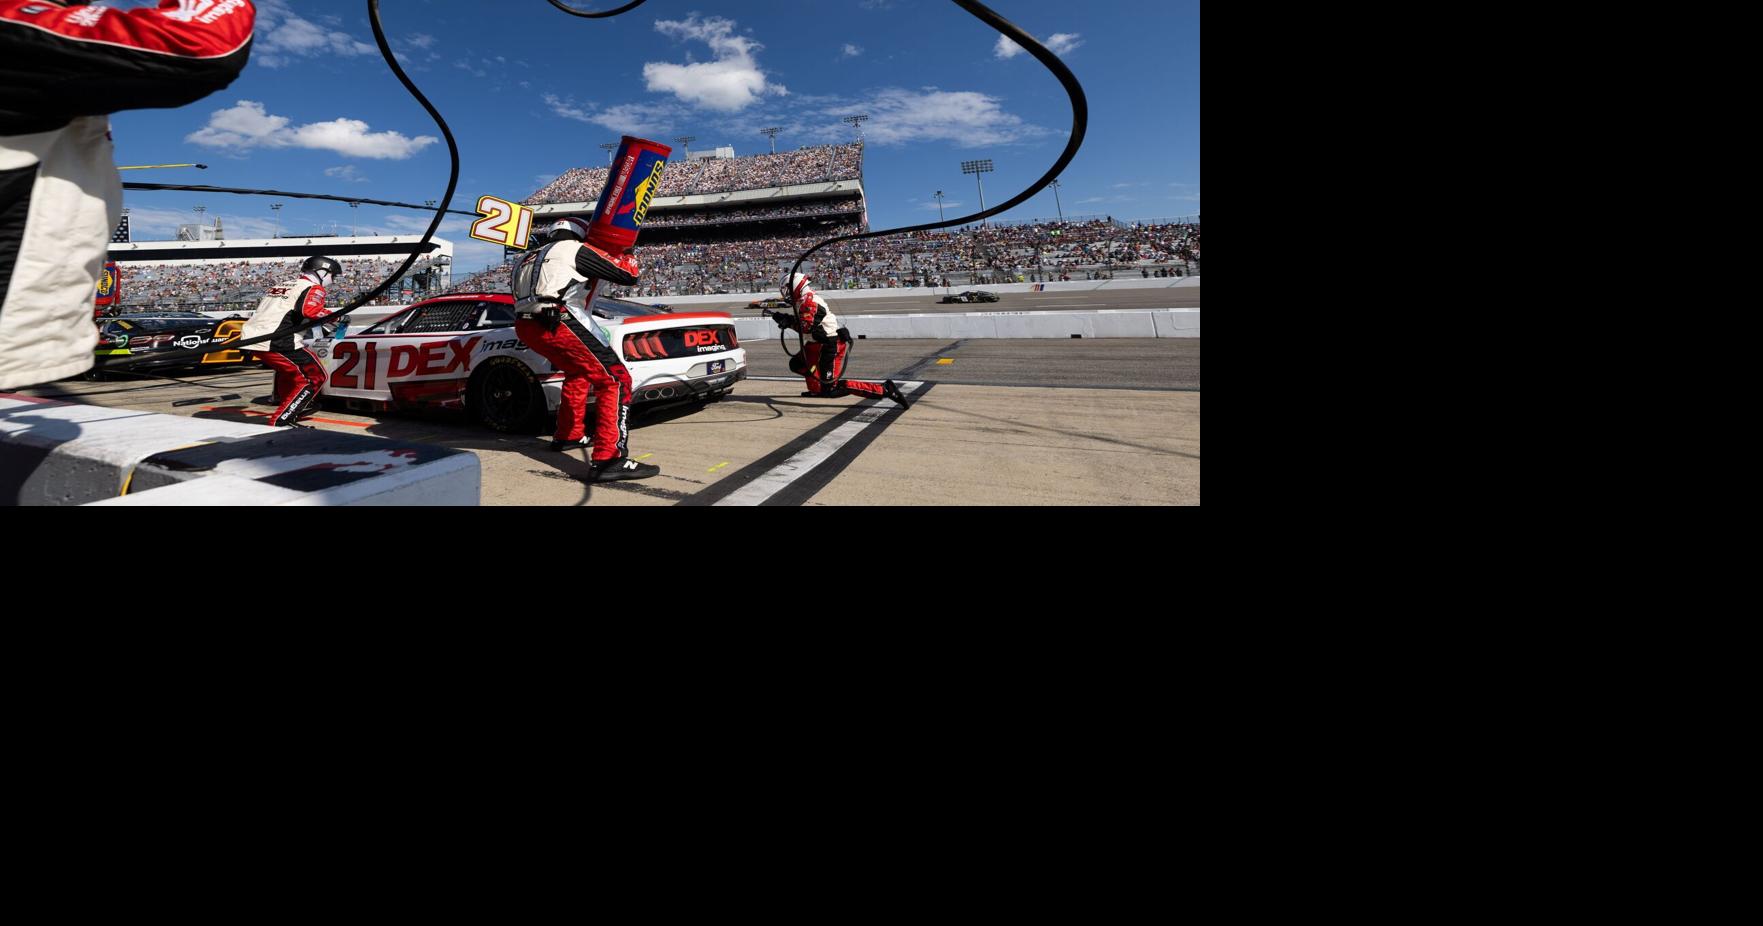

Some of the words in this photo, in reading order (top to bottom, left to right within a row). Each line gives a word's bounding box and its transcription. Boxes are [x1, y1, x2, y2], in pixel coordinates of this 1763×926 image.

[633, 160, 664, 226] SUNOCO
[473, 197, 533, 248] 21
[386, 336, 484, 378] DEX
[480, 338, 530, 353] imag
[684, 329, 719, 348] DEX
[329, 341, 378, 390] 21
